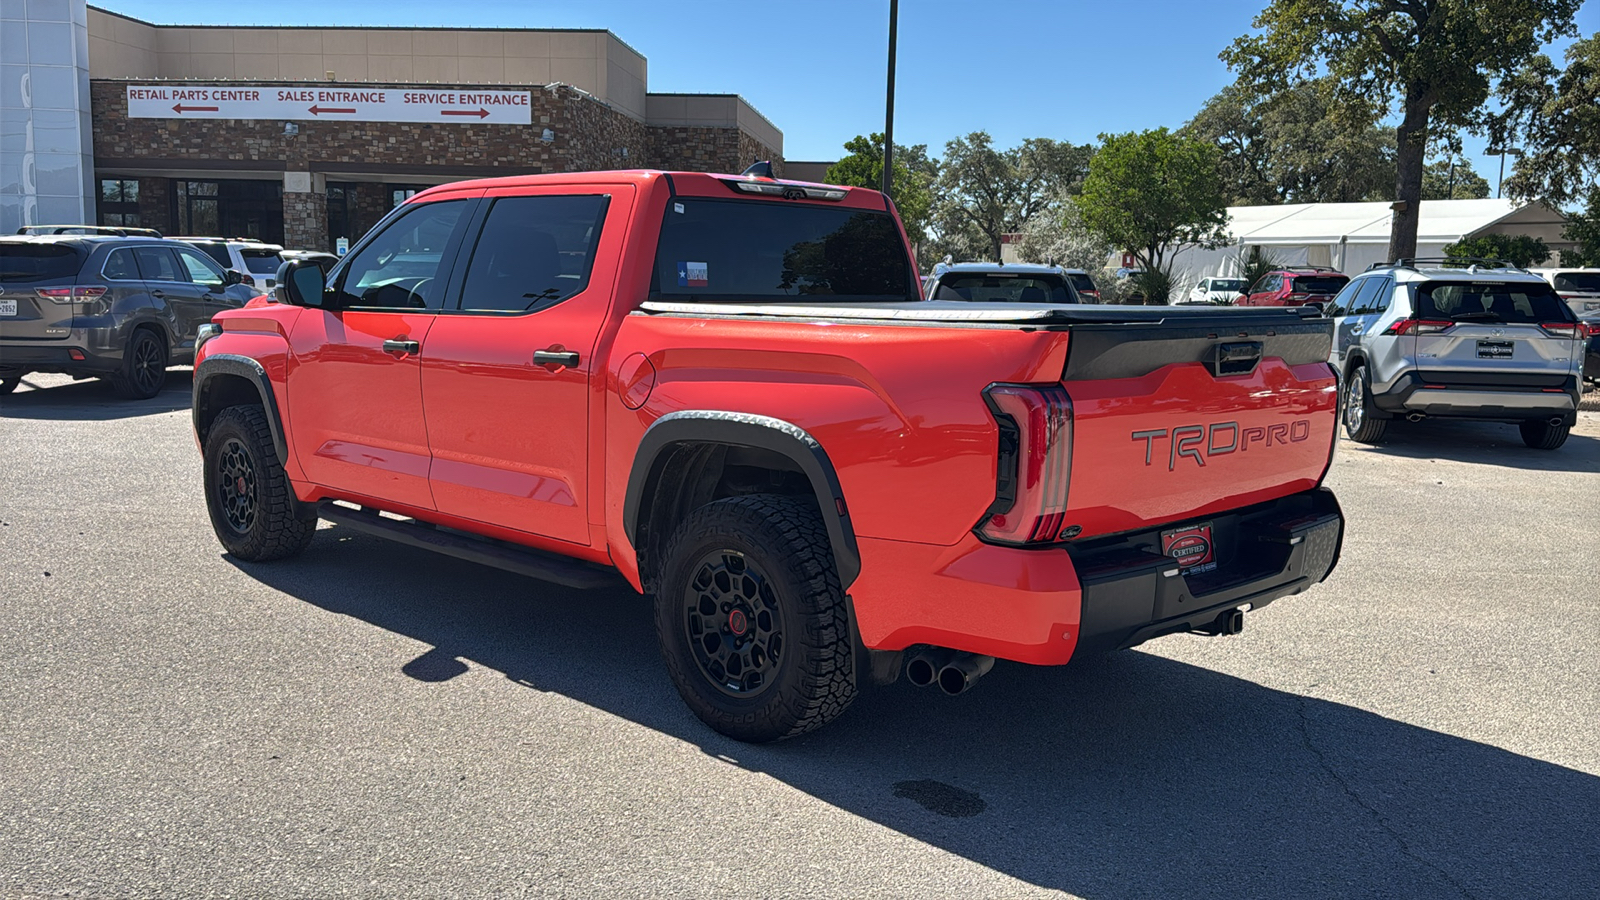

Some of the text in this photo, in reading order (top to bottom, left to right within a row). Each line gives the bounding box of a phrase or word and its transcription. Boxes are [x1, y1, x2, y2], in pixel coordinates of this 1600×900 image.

[129, 89, 260, 101] RETAIL PARTS CENTER
[277, 91, 386, 103] SALES ENTRANCE
[403, 93, 528, 106] SERVICE ENTRANCE
[1132, 419, 1310, 472] TRD PRO
[1172, 545, 1205, 558] CERTIFIED
